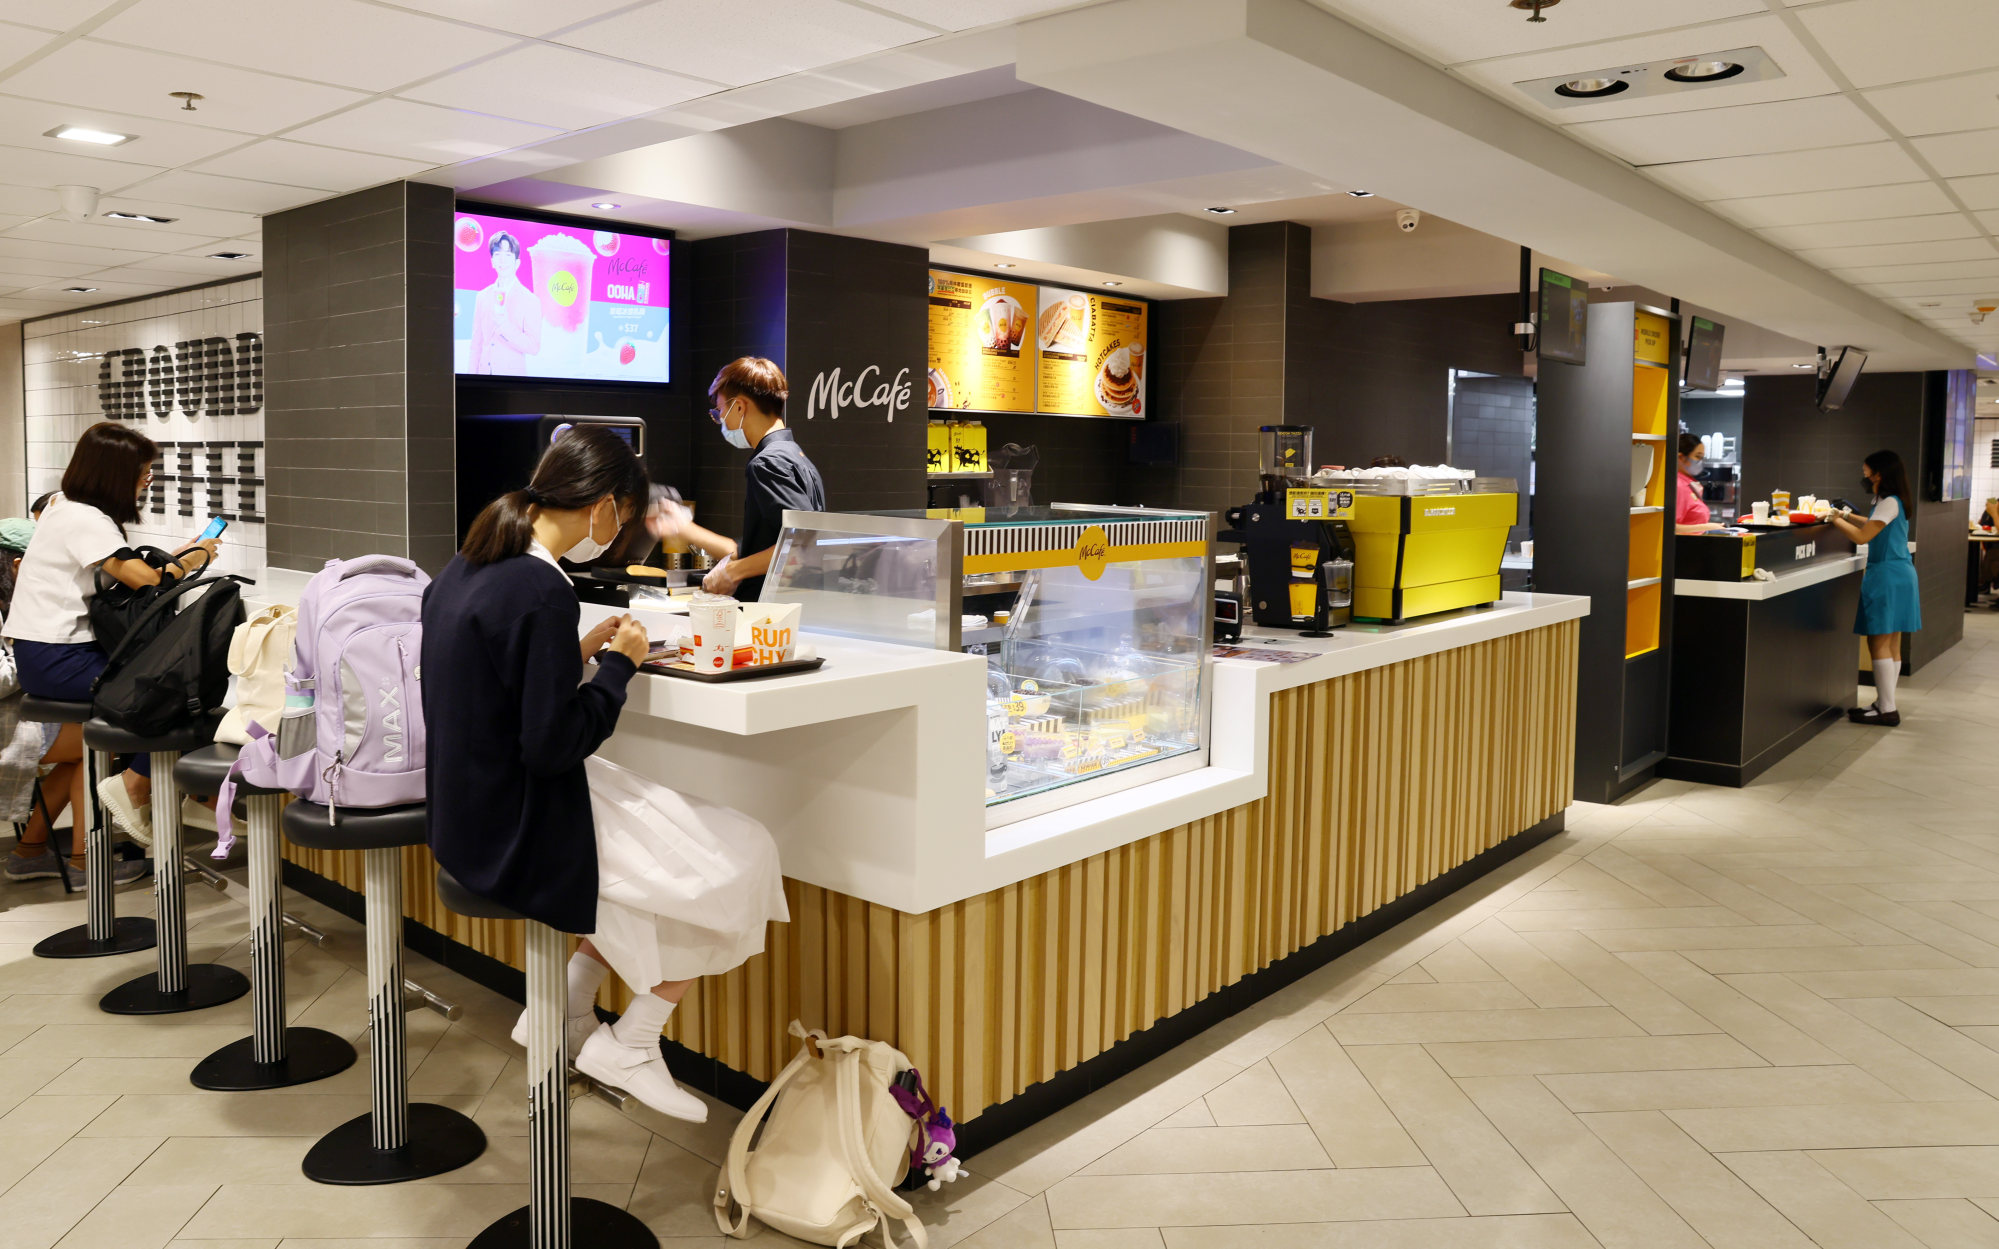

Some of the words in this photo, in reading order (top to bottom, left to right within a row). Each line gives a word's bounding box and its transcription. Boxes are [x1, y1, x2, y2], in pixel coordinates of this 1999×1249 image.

[607, 284, 636, 300] OOHA
[1088, 297, 1097, 342] CIABATTA
[98, 332, 264, 420] GROUND
[1094, 339, 1121, 370] HOTCAKES
[807, 365, 912, 423] McCafé
[137, 441, 264, 523] FFEE
[1079, 544, 1105, 560] McCafé
[379, 686, 403, 763] MAX
